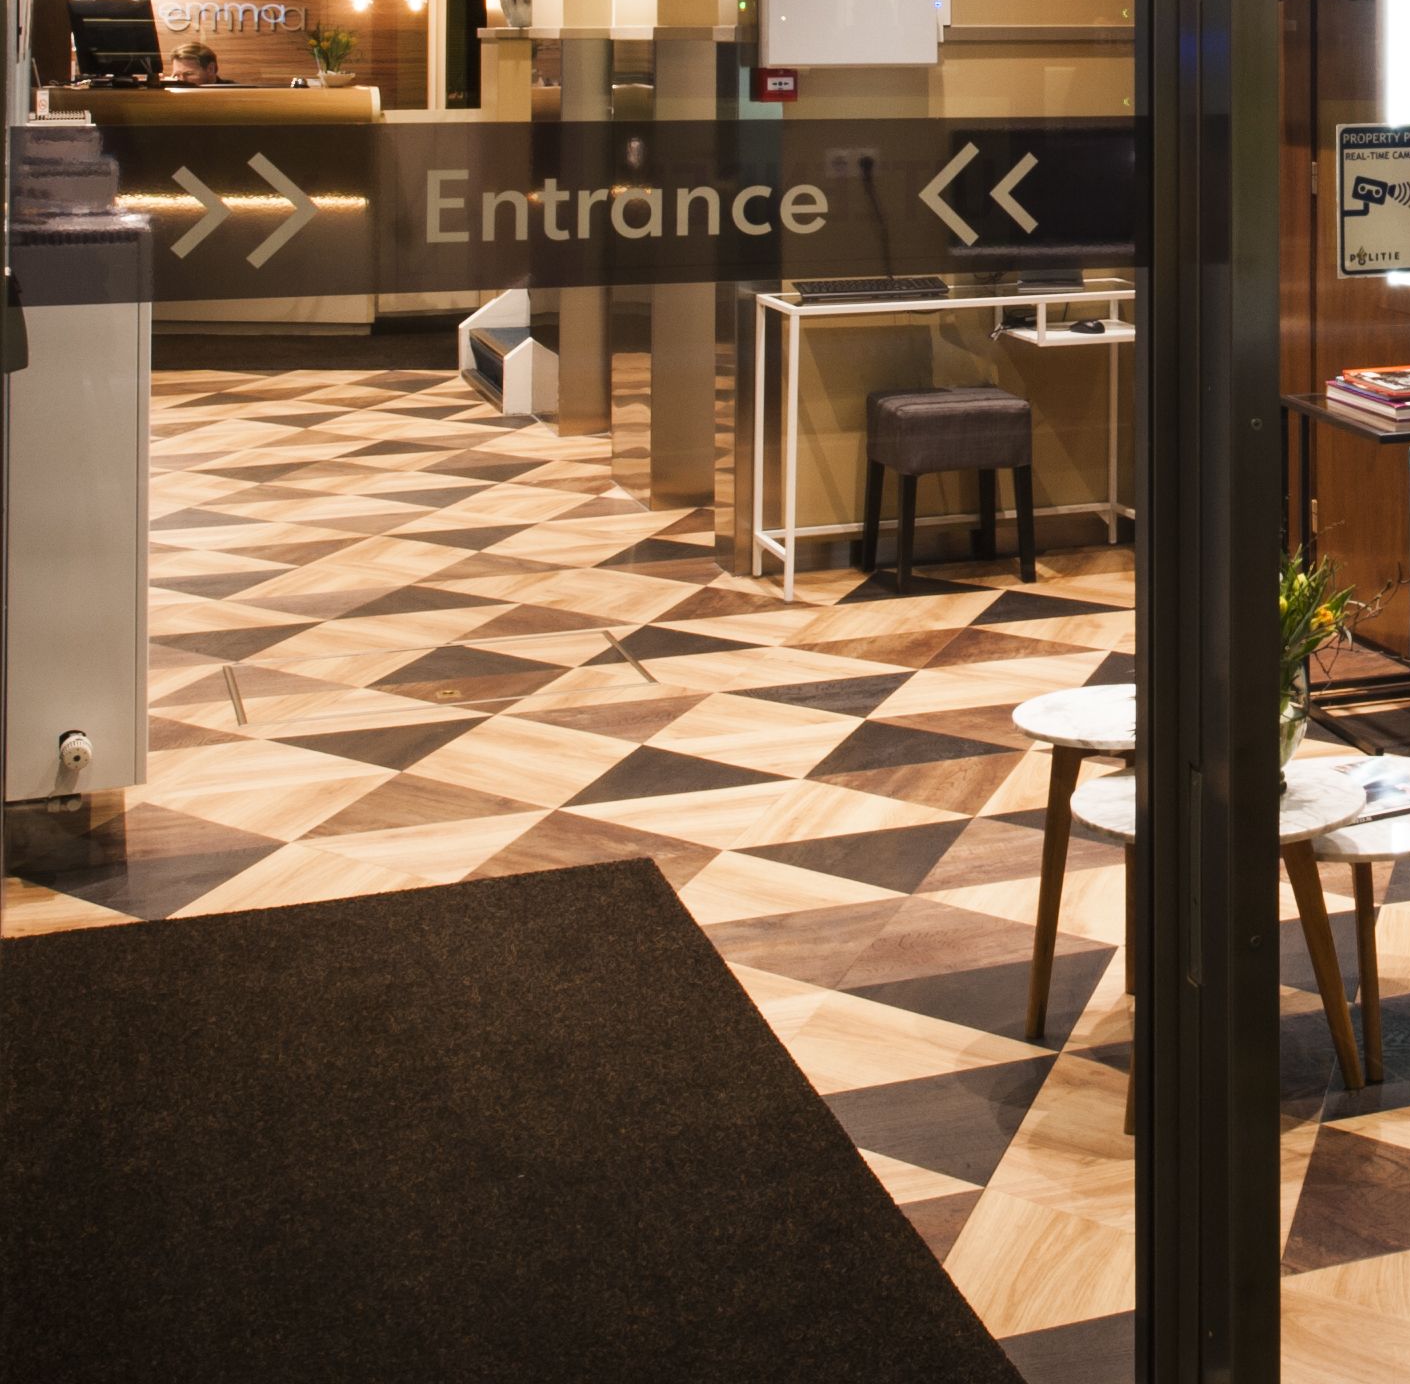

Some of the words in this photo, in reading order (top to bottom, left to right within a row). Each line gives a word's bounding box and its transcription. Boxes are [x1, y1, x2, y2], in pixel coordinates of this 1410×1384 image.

[1342, 132, 1401, 145] PROPERTY
[1344, 151, 1390, 161] REAL-TIME
[426, 169, 829, 243] Entrance
